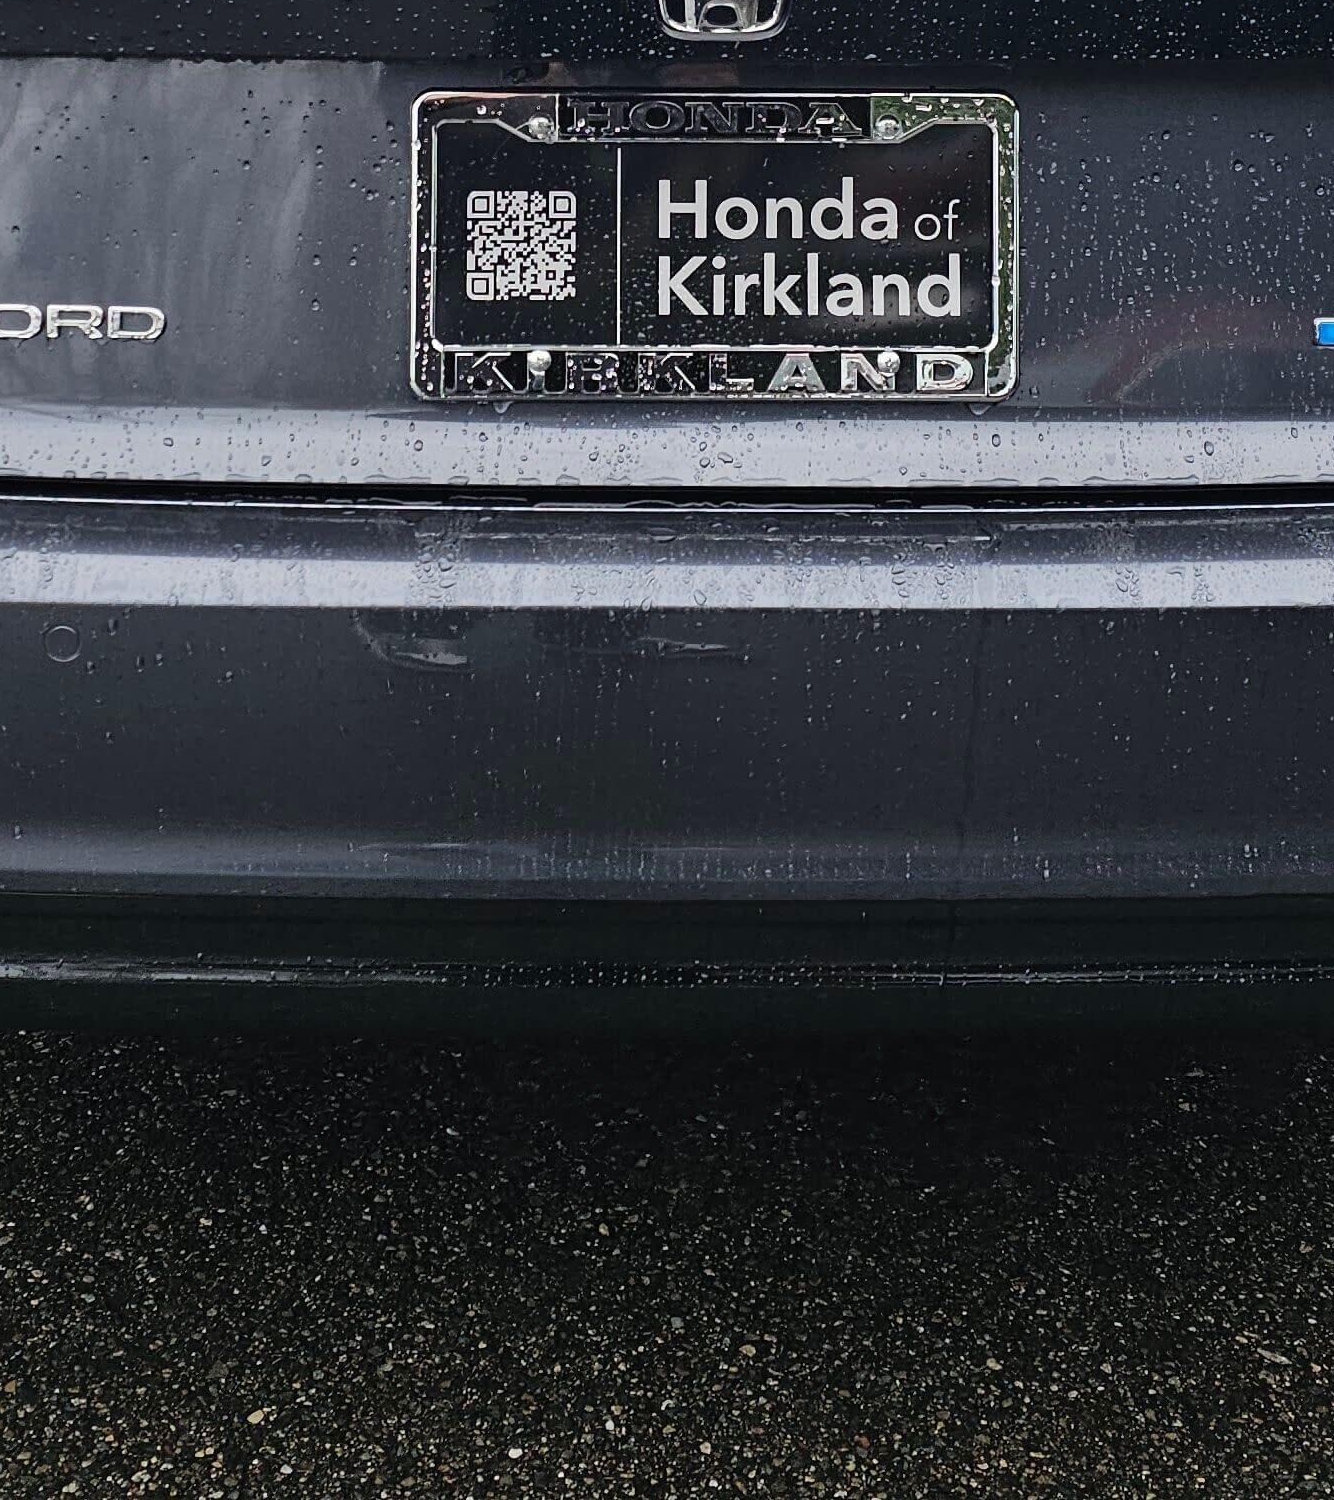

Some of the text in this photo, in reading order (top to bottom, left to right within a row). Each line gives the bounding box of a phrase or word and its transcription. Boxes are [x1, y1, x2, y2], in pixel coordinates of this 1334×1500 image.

[567, 101, 862, 134] HONDA
[658, 176, 960, 240] Honda of
[658, 252, 961, 316] Kirkland
